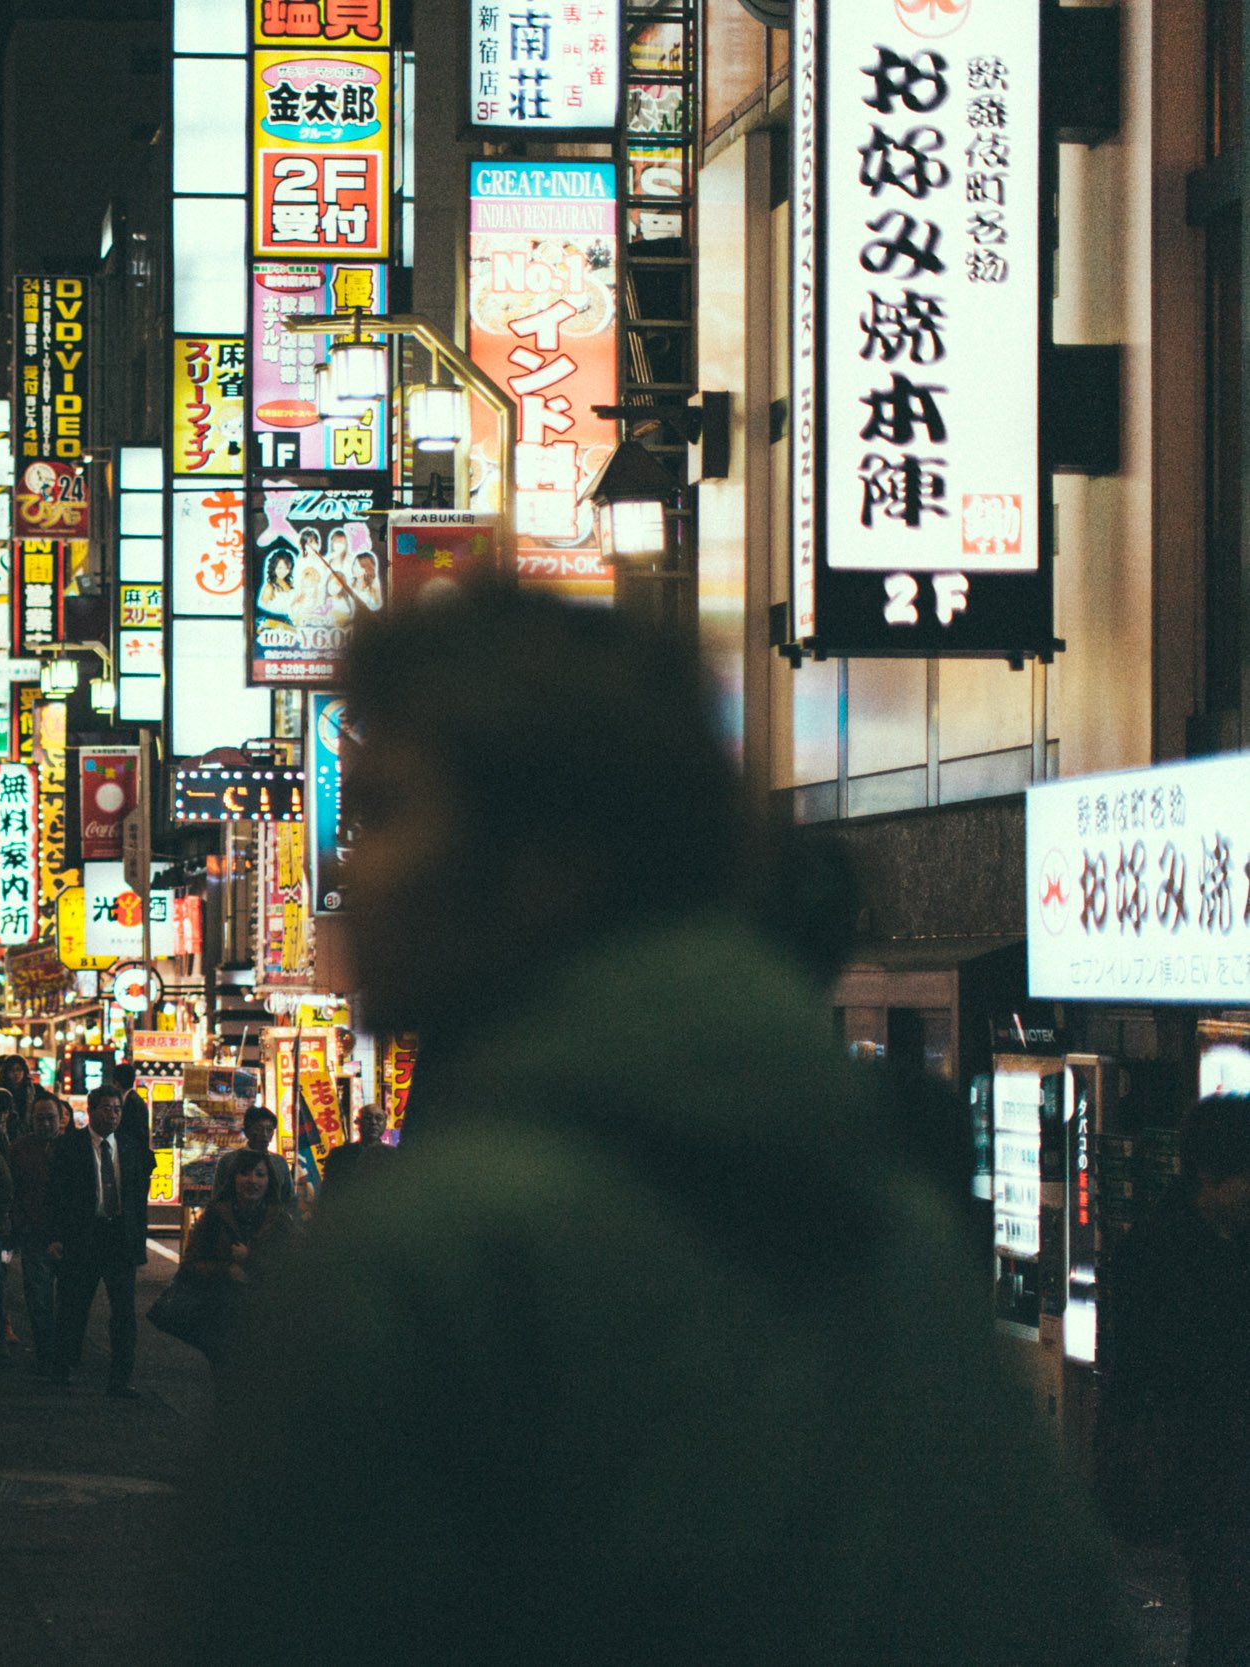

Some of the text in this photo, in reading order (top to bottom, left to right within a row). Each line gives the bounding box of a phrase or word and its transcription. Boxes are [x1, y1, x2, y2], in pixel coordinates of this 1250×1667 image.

[479, 5, 500, 97] 新宿店
[509, 0, 553, 121] 南荘
[267, 82, 375, 122] 金太郎
[477, 101, 501, 121] 3F
[299, 127, 343, 140] グループ
[273, 157, 367, 203] 2F
[964, 55, 1010, 283] 歌舞伎町名物
[272, 204, 368, 242] 受付
[477, 204, 606, 229] INDIAN RESTAURANT
[492, 250, 585, 293] No.1
[217, 343, 244, 399] 麻雀
[185, 342, 215, 471] スリーファイブ
[257, 432, 296, 468] 1F
[59, 475, 84, 502] 24
[288, 490, 374, 521] ZONE
[123, 589, 162, 605] 麻雀
[882, 572, 970, 627] 2F
[0, 773, 29, 936] 無料案内所
[1079, 829, 1250, 937] お好み焼
[80, 957, 97, 967] B1
